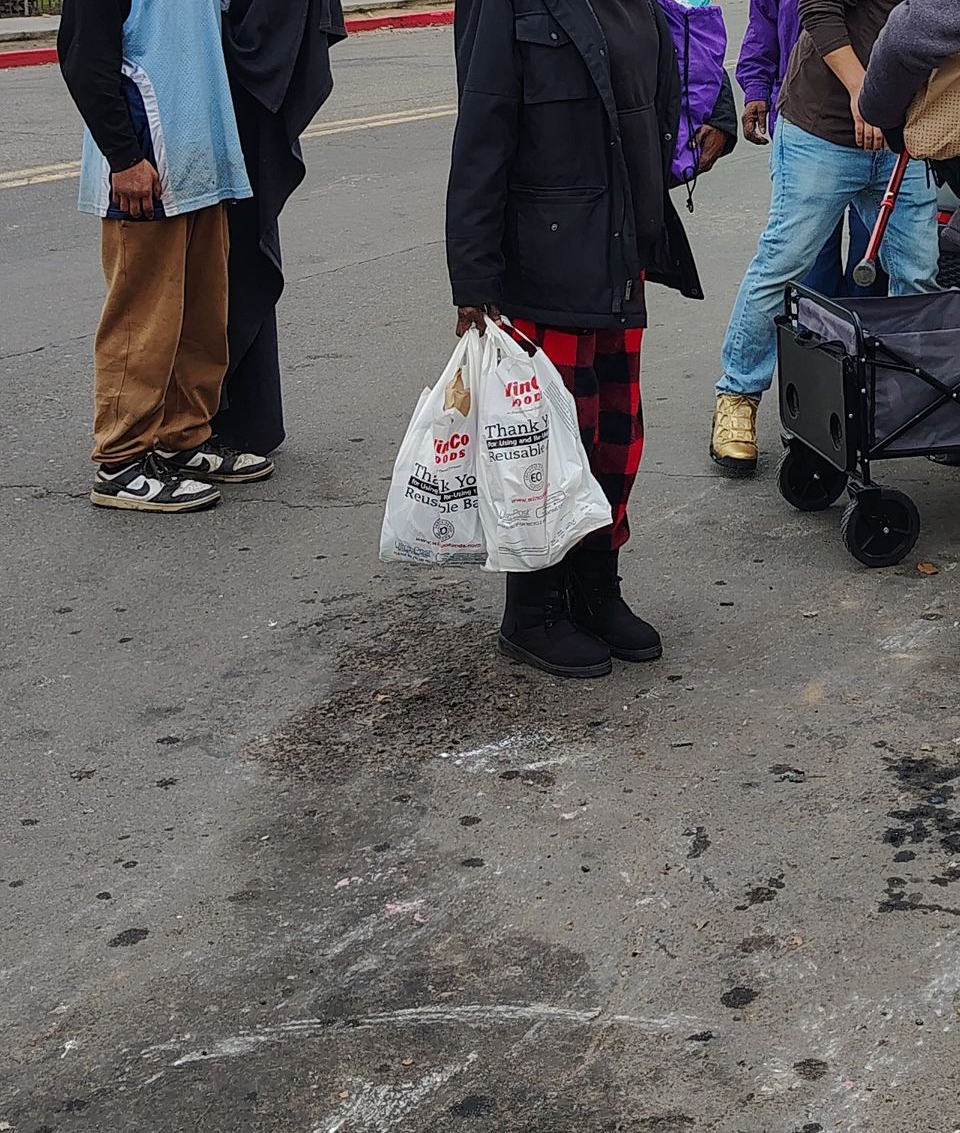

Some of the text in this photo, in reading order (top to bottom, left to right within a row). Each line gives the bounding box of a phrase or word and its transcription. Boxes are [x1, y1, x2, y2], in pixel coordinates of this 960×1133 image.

[505, 375, 539, 397] inC
[512, 392, 542, 407] OOD
[485, 419, 539, 438] Thank
[434, 433, 470, 454] inCo
[499, 438, 518, 446] Using
[519, 436, 532, 444] and
[435, 449, 466, 464] OODS
[488, 443, 545, 462] Reusable
[414, 462, 477, 493] Thak Yo
[404, 487, 478, 513] Reusle Ba
